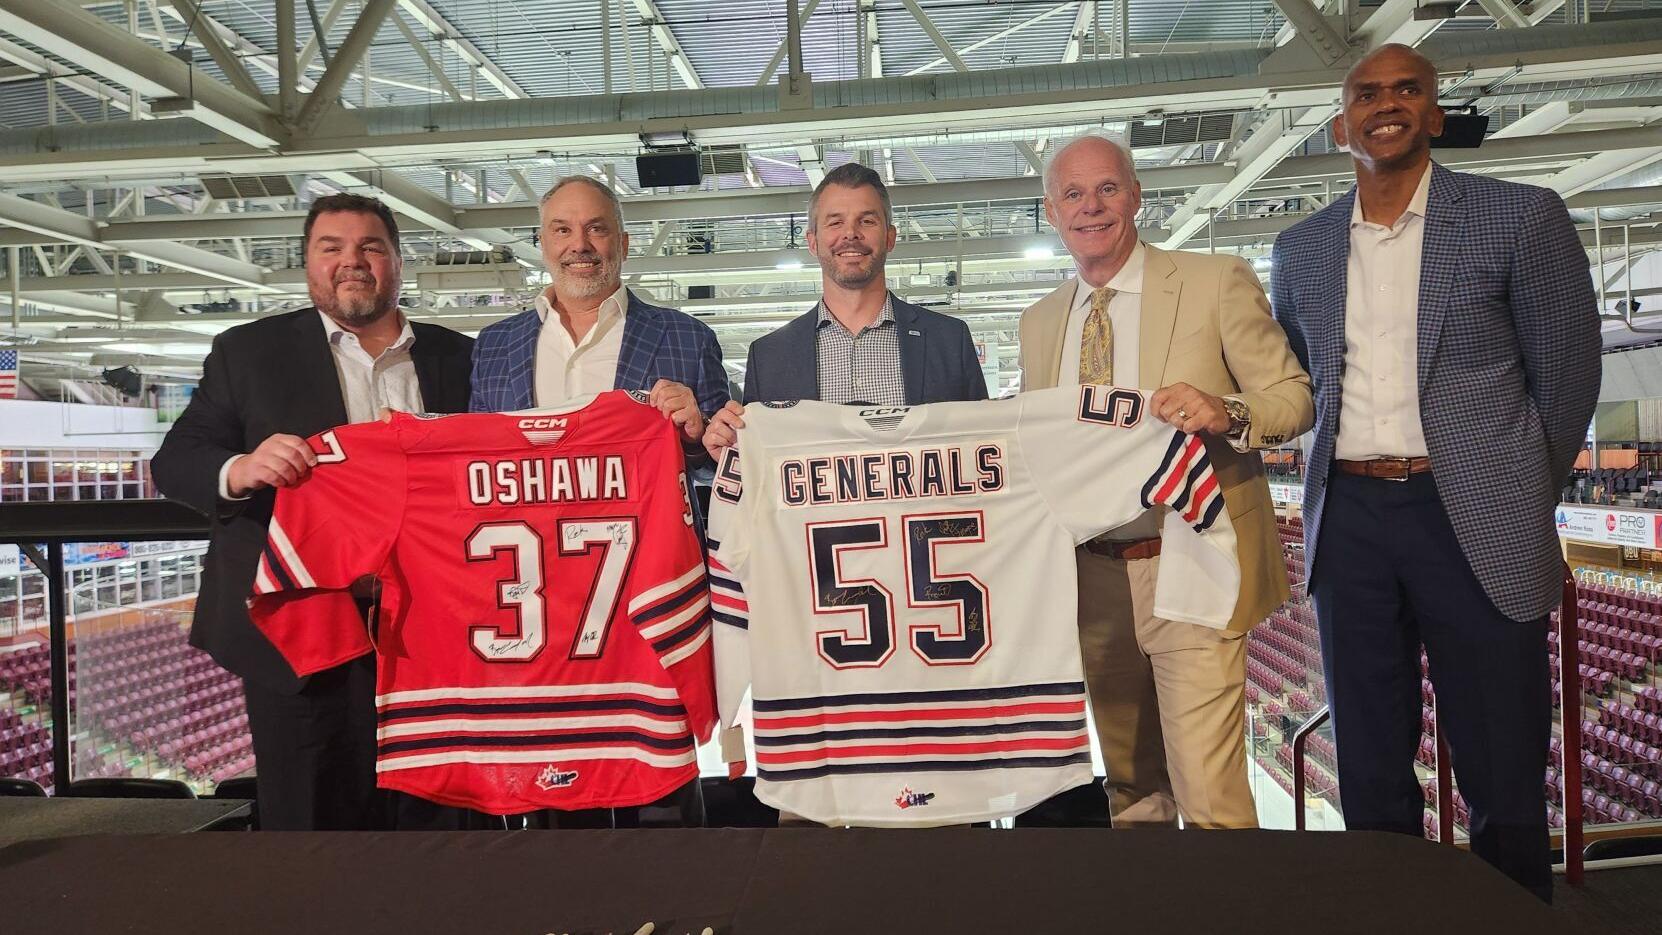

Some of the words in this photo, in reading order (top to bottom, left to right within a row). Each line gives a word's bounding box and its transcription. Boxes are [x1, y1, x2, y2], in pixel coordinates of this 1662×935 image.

[518, 418, 568, 429] CCM
[859, 407, 910, 417] CCM
[1078, 384, 1145, 429] 5
[467, 455, 627, 505] OSHAWA
[780, 444, 1004, 506] GENERALS
[1619, 514, 1646, 528] PRO
[464, 516, 638, 663] 37
[805, 510, 992, 670] 55
